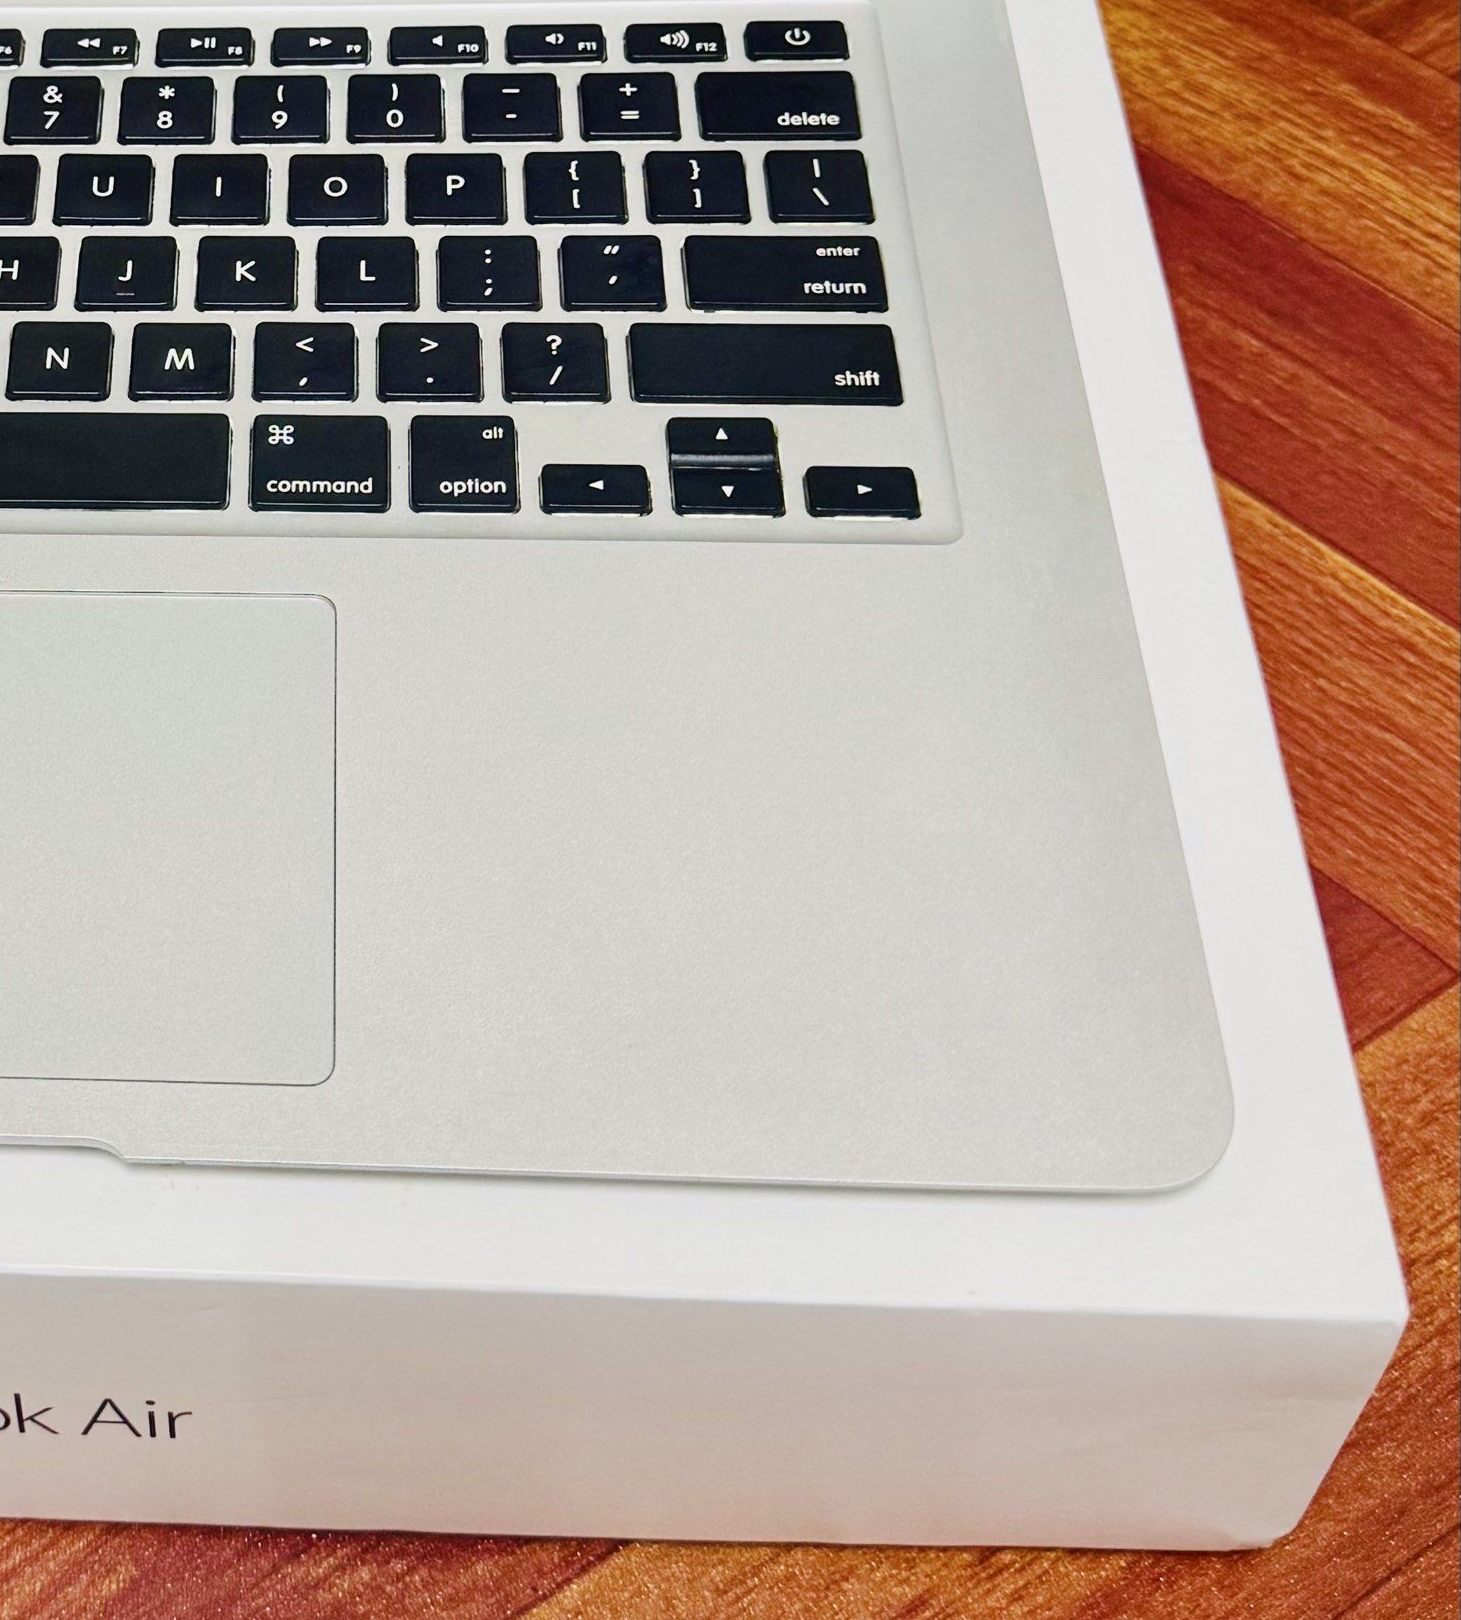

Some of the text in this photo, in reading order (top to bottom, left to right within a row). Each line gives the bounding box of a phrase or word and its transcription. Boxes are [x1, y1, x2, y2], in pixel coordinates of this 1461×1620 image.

[113, 46, 128, 56] F7
[228, 47, 242, 55] F8
[347, 45, 361, 53] F9
[458, 44, 479, 52] F10
[578, 42, 596, 50] F11
[696, 43, 717, 51] F12
[44, 111, 59, 129] 7
[157, 111, 172, 128] 8
[272, 111, 287, 129] 9
[778, 112, 840, 125] delete
[93, 177, 114, 196] U
[216, 177, 221, 196] I
[324, 177, 347, 197] O
[447, 175, 465, 195] P
[816, 246, 860, 256] enter
[119, 260, 132, 281] J
[236, 261, 255, 281] K
[360, 260, 375, 281] L
[804, 281, 866, 294] return
[46, 347, 69, 369] N
[165, 348, 194, 369] M
[835, 370, 879, 386] shift
[483, 427, 503, 439] alt
[267, 478, 372, 493] command
[440, 478, 506, 497] option
[81, 1398, 193, 1439] Air
